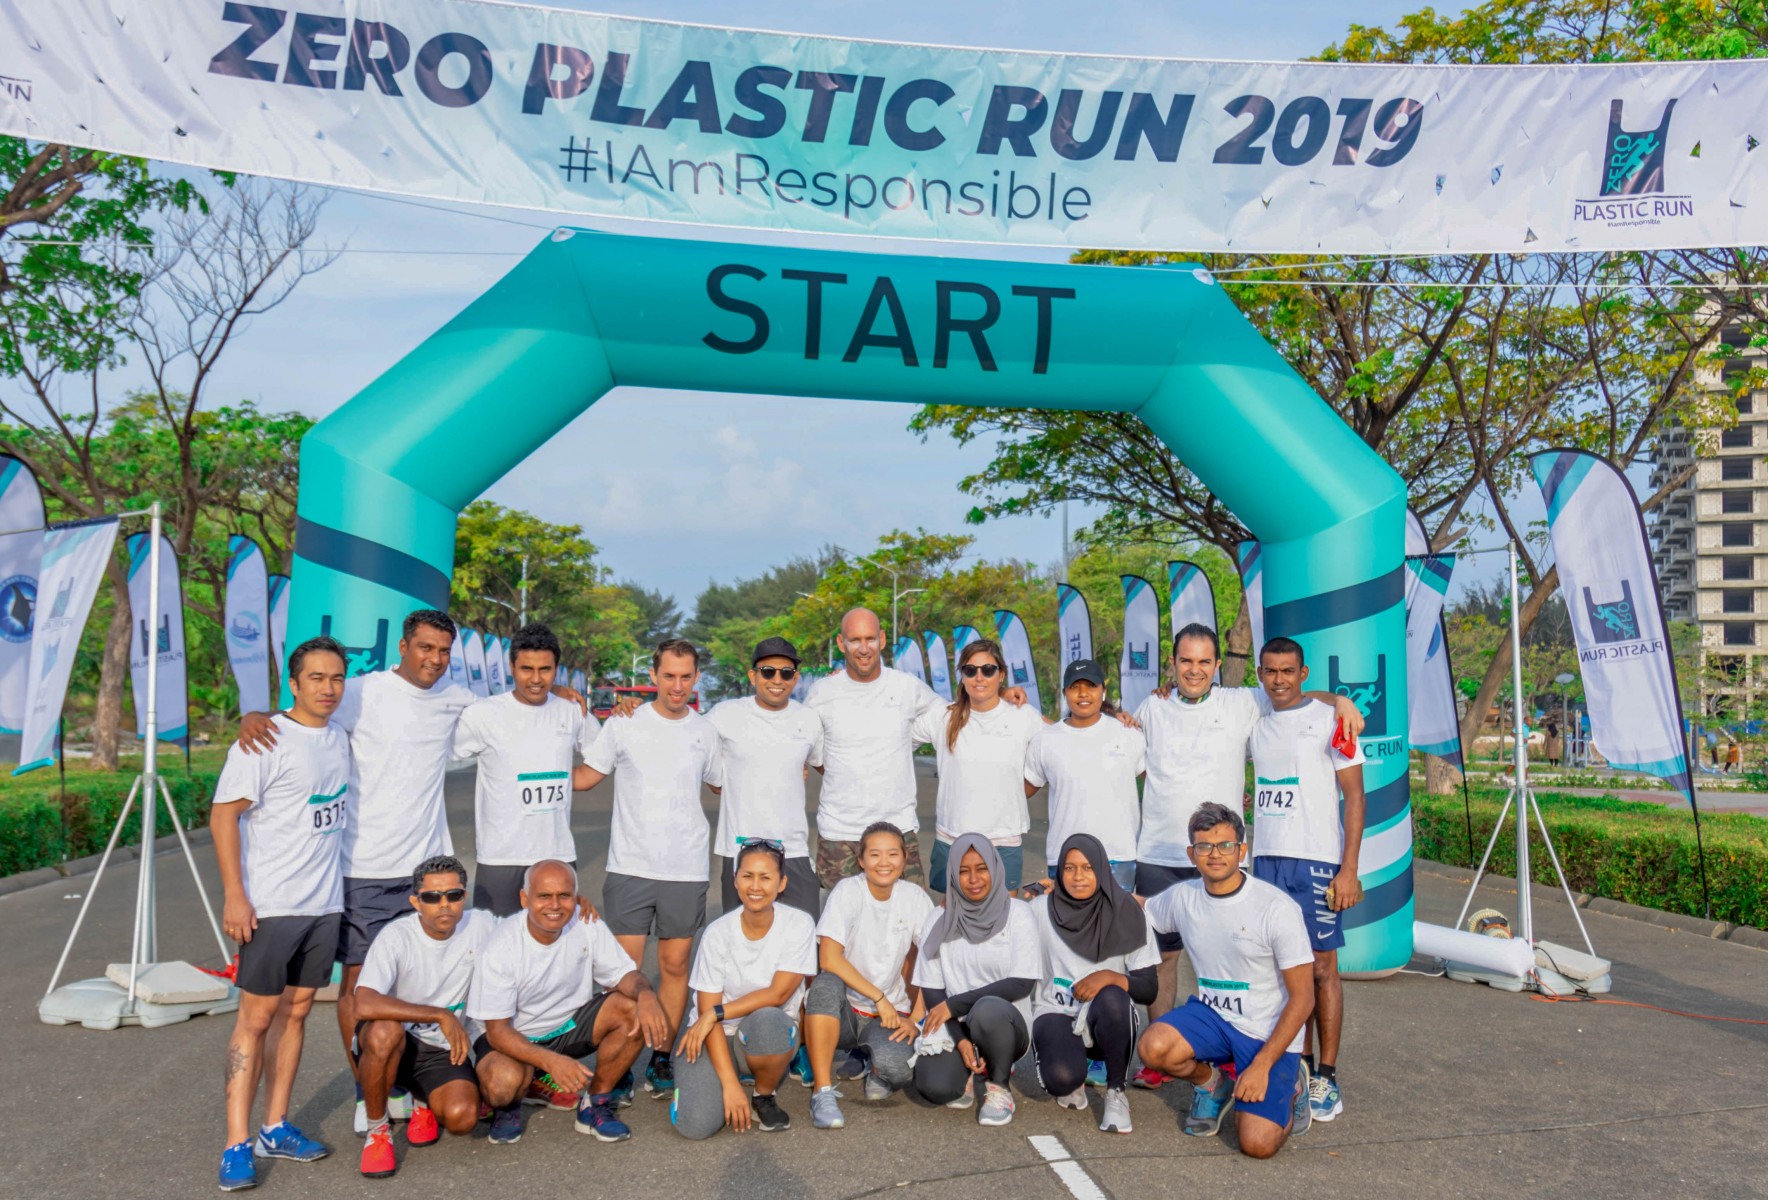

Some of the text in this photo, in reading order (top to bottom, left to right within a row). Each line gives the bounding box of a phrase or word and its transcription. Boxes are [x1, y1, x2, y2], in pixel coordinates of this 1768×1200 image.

[209, 2, 1424, 167] ZERO PLASTIC RUN 2019
[559, 136, 1092, 221] #IAmResponsible
[1605, 134, 1631, 193] ZERO
[1574, 200, 1693, 221] PLASTIC RUN
[702, 264, 1076, 375] START
[1378, 740, 1403, 757] RUN
[522, 785, 564, 805] 0175
[1258, 790, 1294, 808] 0742
[1310, 866, 1337, 925] NIKE
